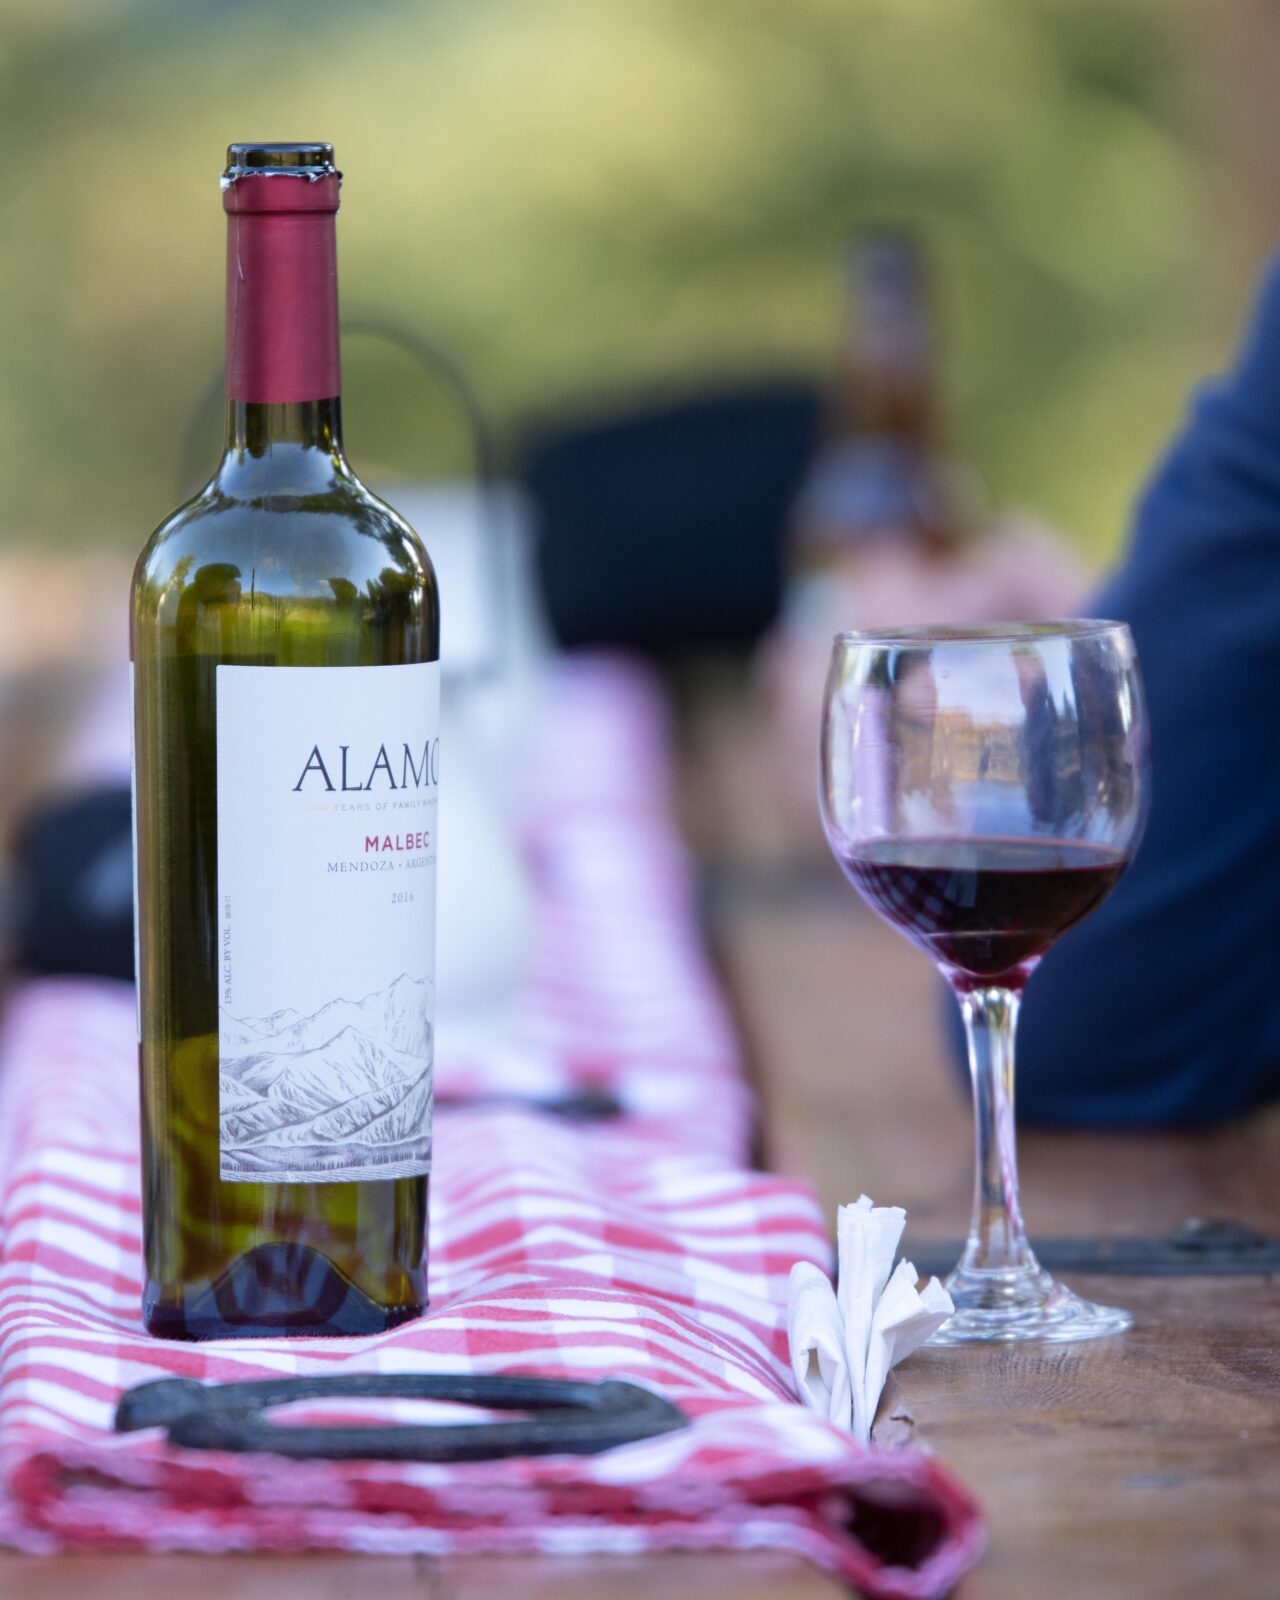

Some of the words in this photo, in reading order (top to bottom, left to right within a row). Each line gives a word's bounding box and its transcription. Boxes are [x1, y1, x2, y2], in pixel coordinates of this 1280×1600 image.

[292, 737, 439, 792] ALAMO
[334, 802, 371, 812] YEARS
[375, 802, 389, 811] OF
[392, 800, 421, 809] FAMILY
[364, 831, 430, 853] MALBEC
[327, 860, 394, 873] MENDOZA
[391, 891, 414, 904] 2016
[223, 949, 232, 961] BY
